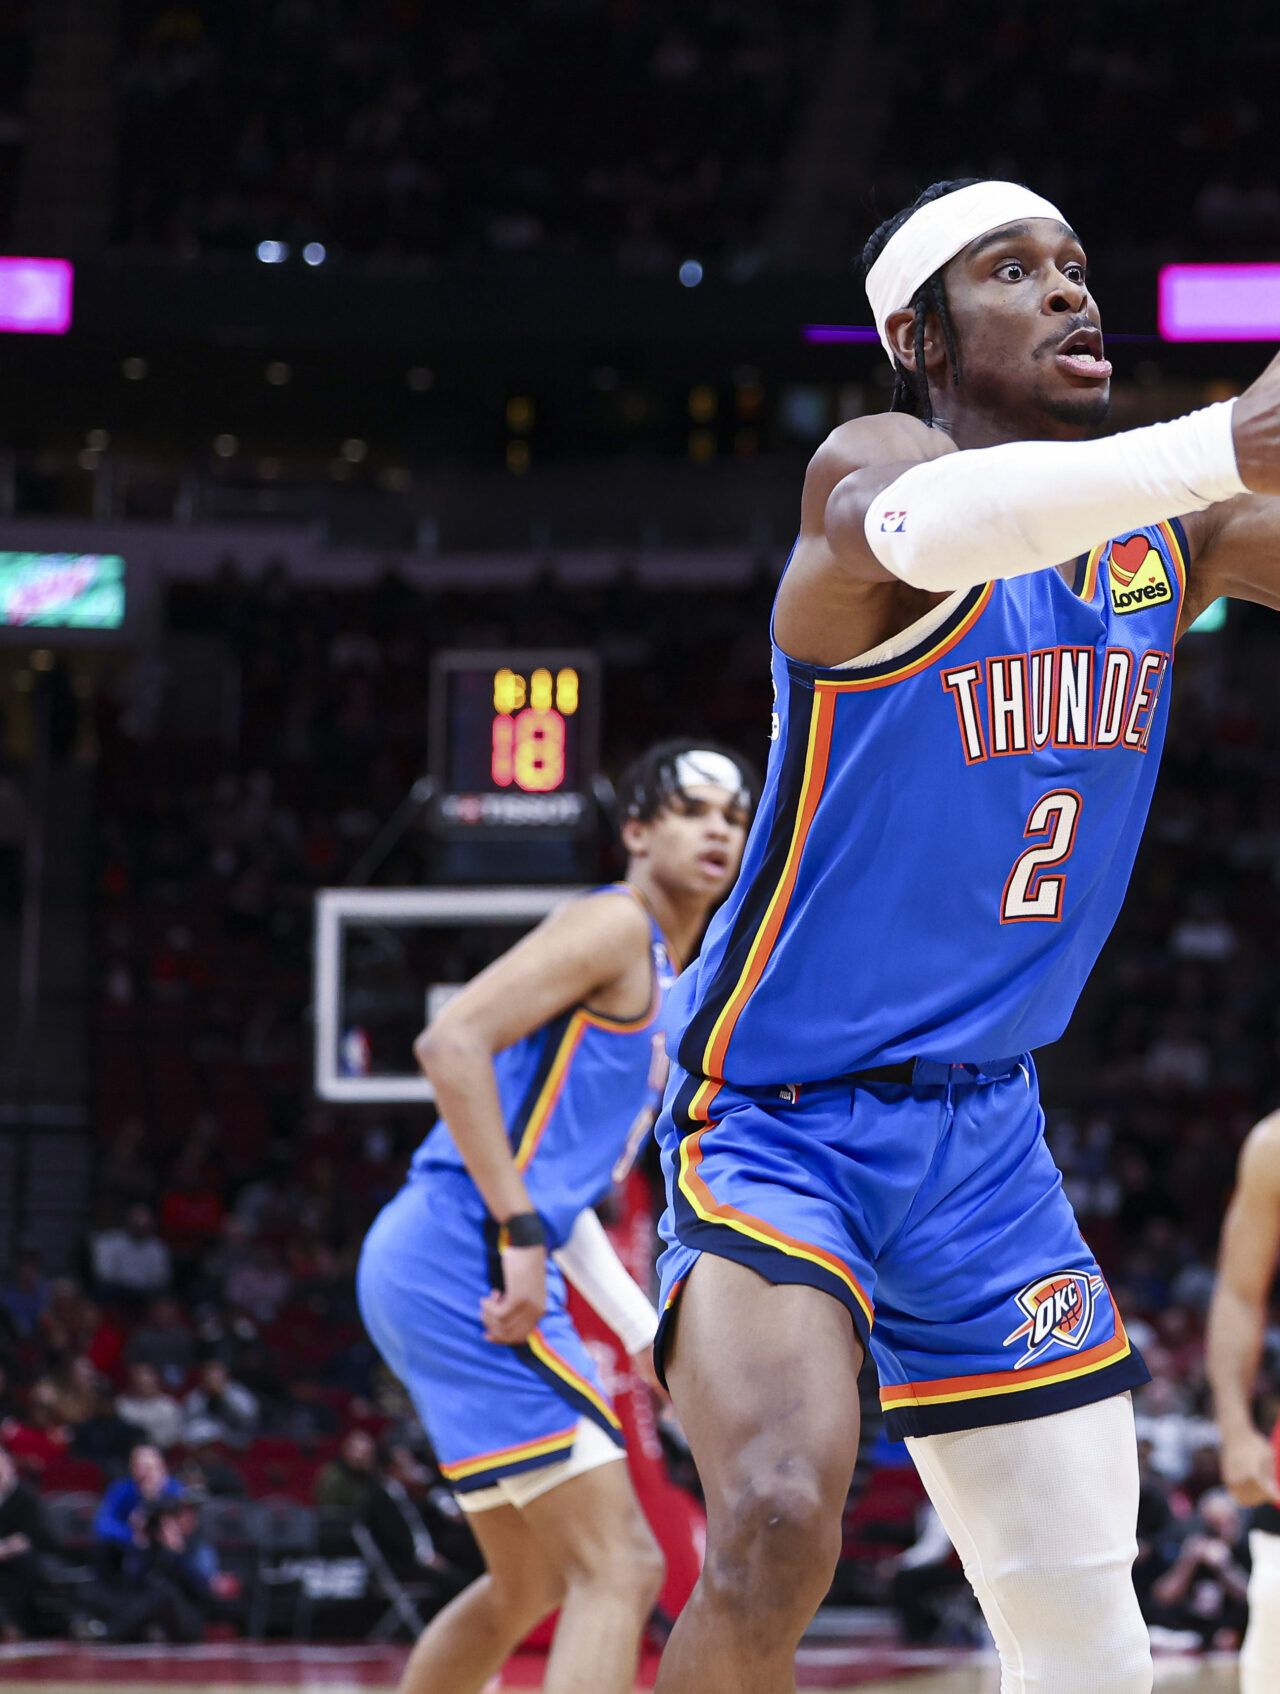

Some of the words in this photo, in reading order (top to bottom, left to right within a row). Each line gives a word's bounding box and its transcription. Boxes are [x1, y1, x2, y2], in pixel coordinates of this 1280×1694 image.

[1112, 582, 1168, 608] Loves
[940, 645, 1169, 765] THUNDE
[492, 707, 566, 792] 18
[1000, 788, 1083, 925] 2
[1033, 1281, 1079, 1345] OKC
